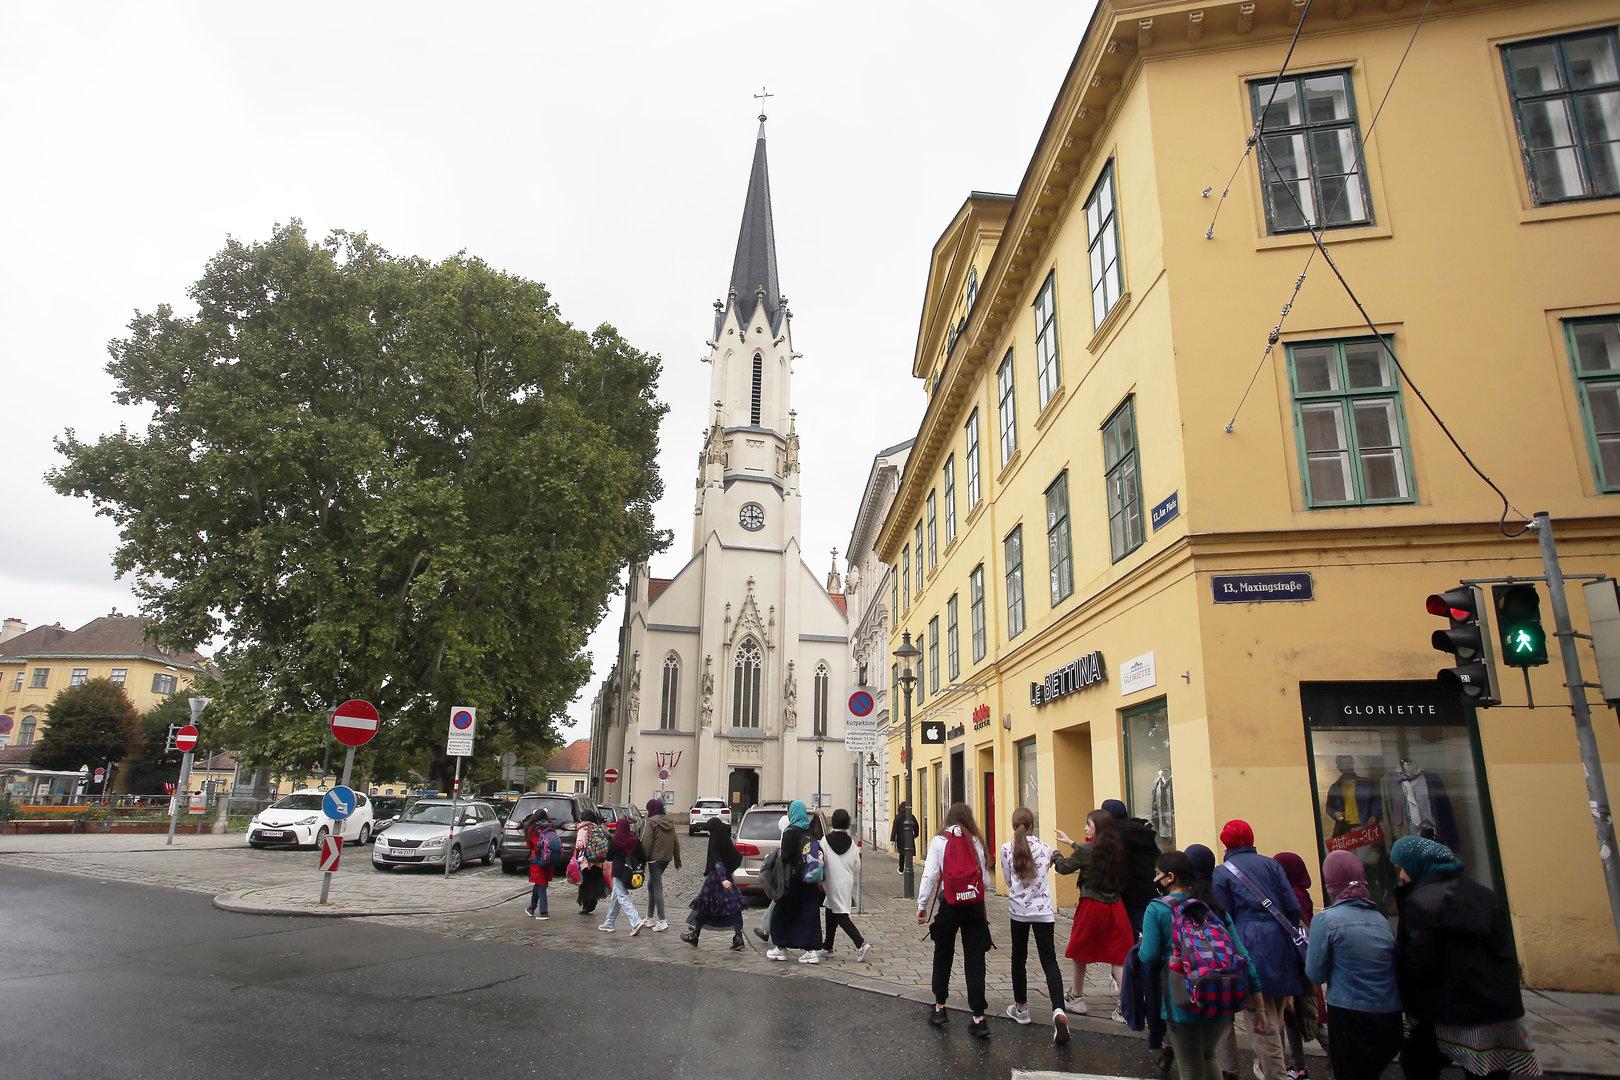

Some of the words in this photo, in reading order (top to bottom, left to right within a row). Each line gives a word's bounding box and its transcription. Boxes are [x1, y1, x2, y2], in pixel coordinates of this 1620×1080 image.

[1222, 583, 1238, 594] 13.,
[1239, 580, 1303, 593] Maxingstraße
[1029, 681, 1042, 707] LE
[1044, 651, 1102, 702] BETTINA
[1343, 705, 1437, 715] GLORIETTE
[955, 890, 977, 901] PUMA
